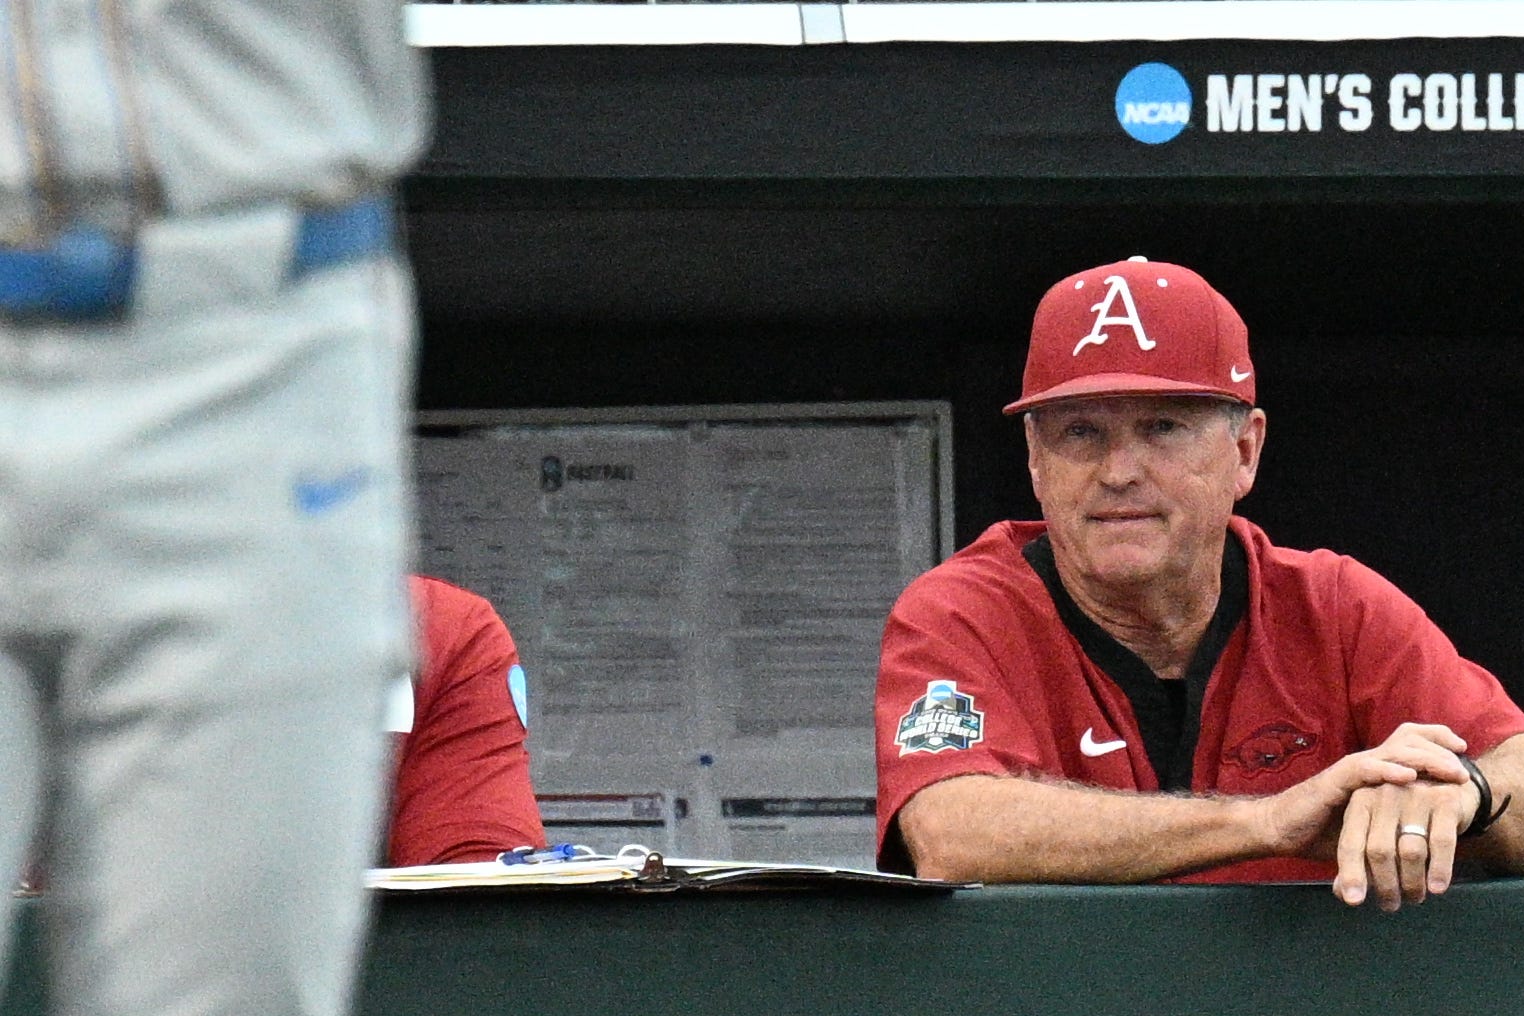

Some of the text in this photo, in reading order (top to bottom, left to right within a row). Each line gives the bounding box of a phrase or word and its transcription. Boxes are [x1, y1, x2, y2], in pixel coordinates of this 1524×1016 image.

[1124, 101, 1190, 124] NCAA
[1206, 74, 1373, 132] MEN'S
[1073, 275, 1156, 356] A
